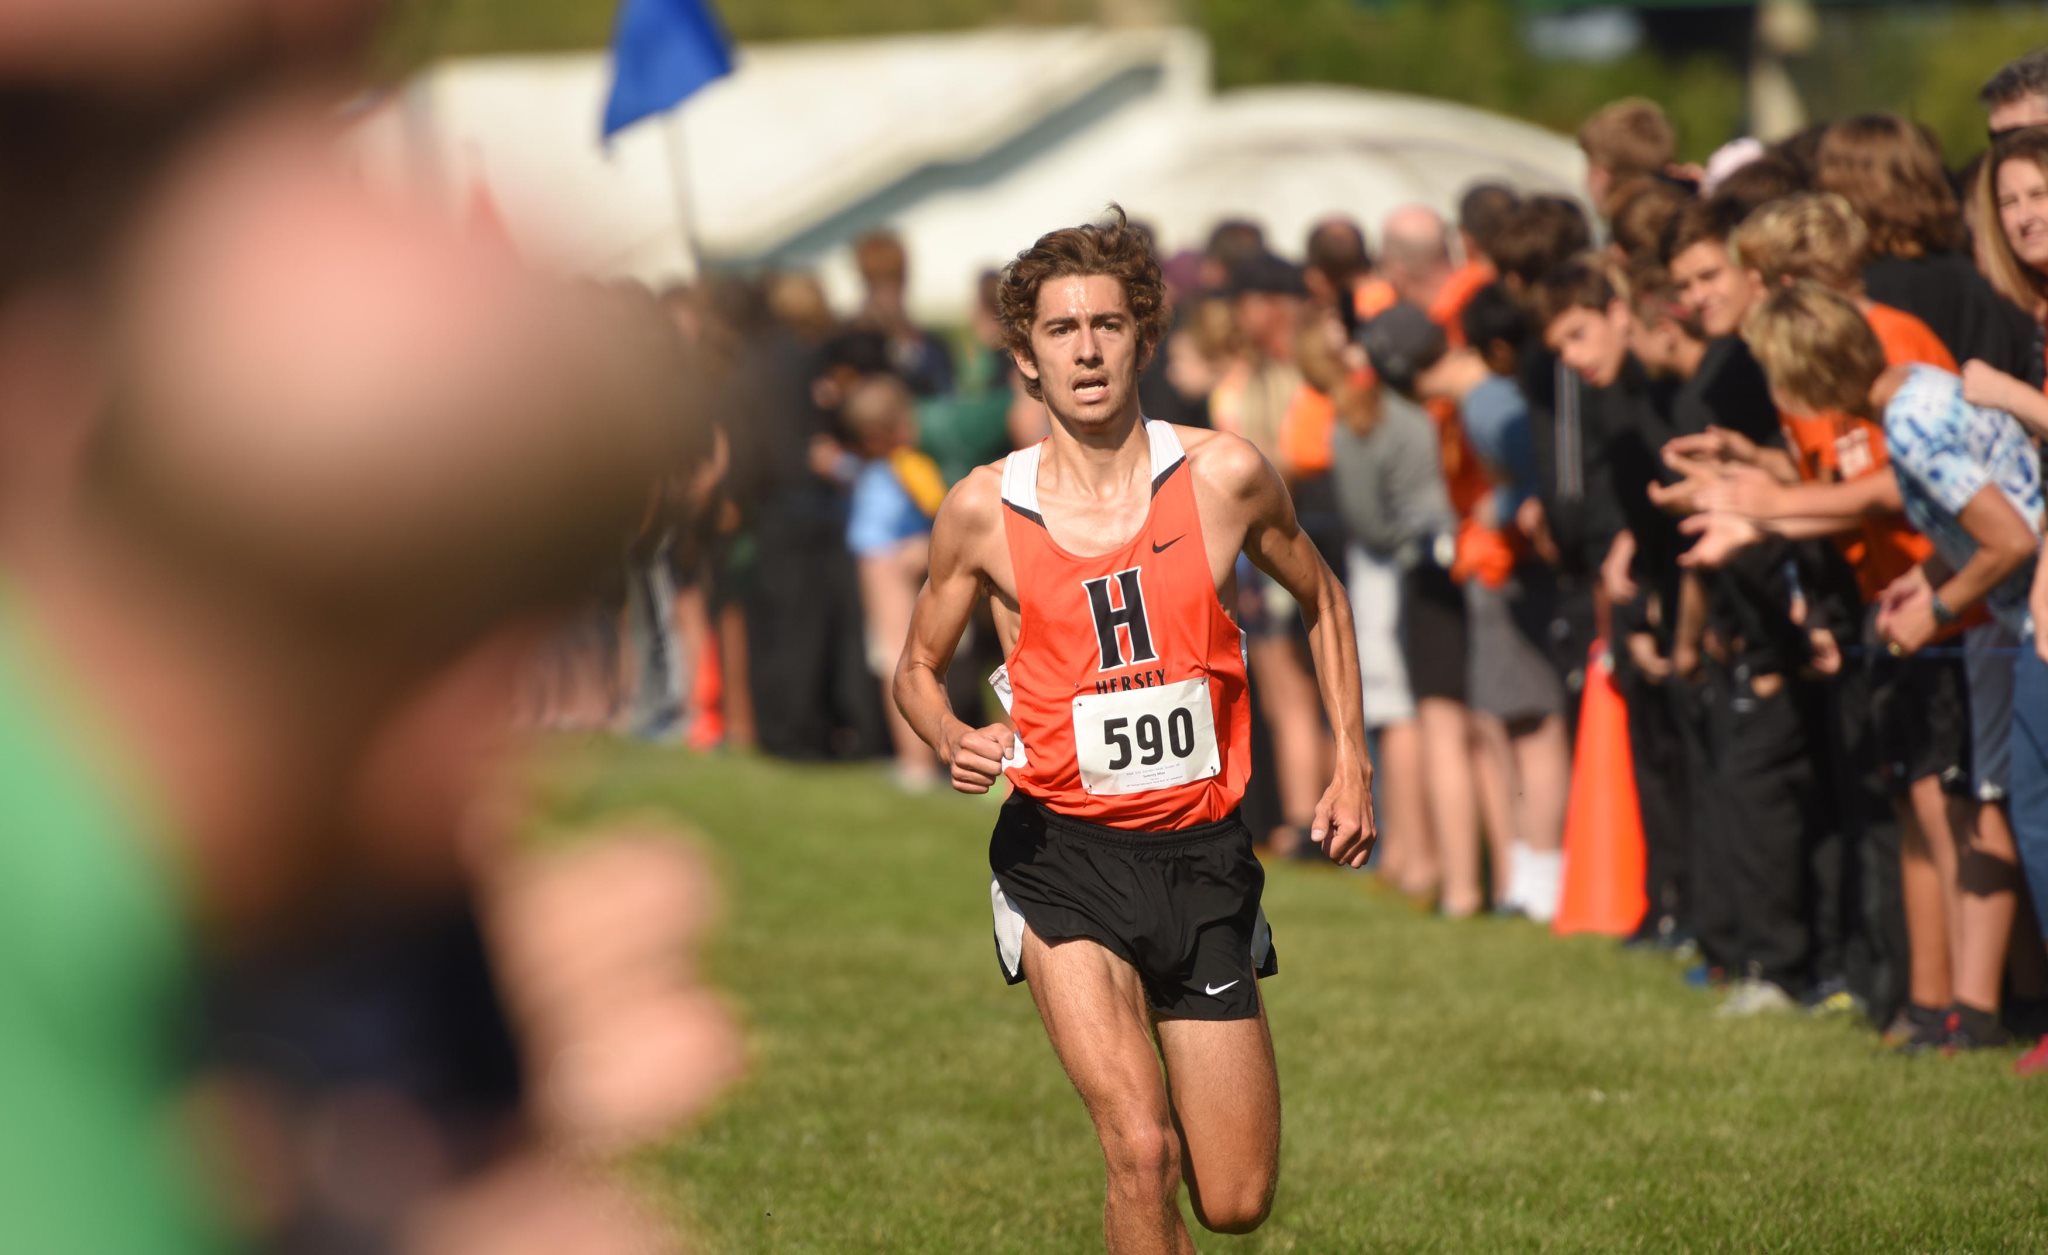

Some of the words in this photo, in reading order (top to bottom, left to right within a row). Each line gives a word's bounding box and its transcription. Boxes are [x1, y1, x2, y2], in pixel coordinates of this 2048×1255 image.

[1082, 566, 1159, 672] H
[1095, 668, 1166, 695] HERSEY
[1103, 707, 1195, 770] 590
